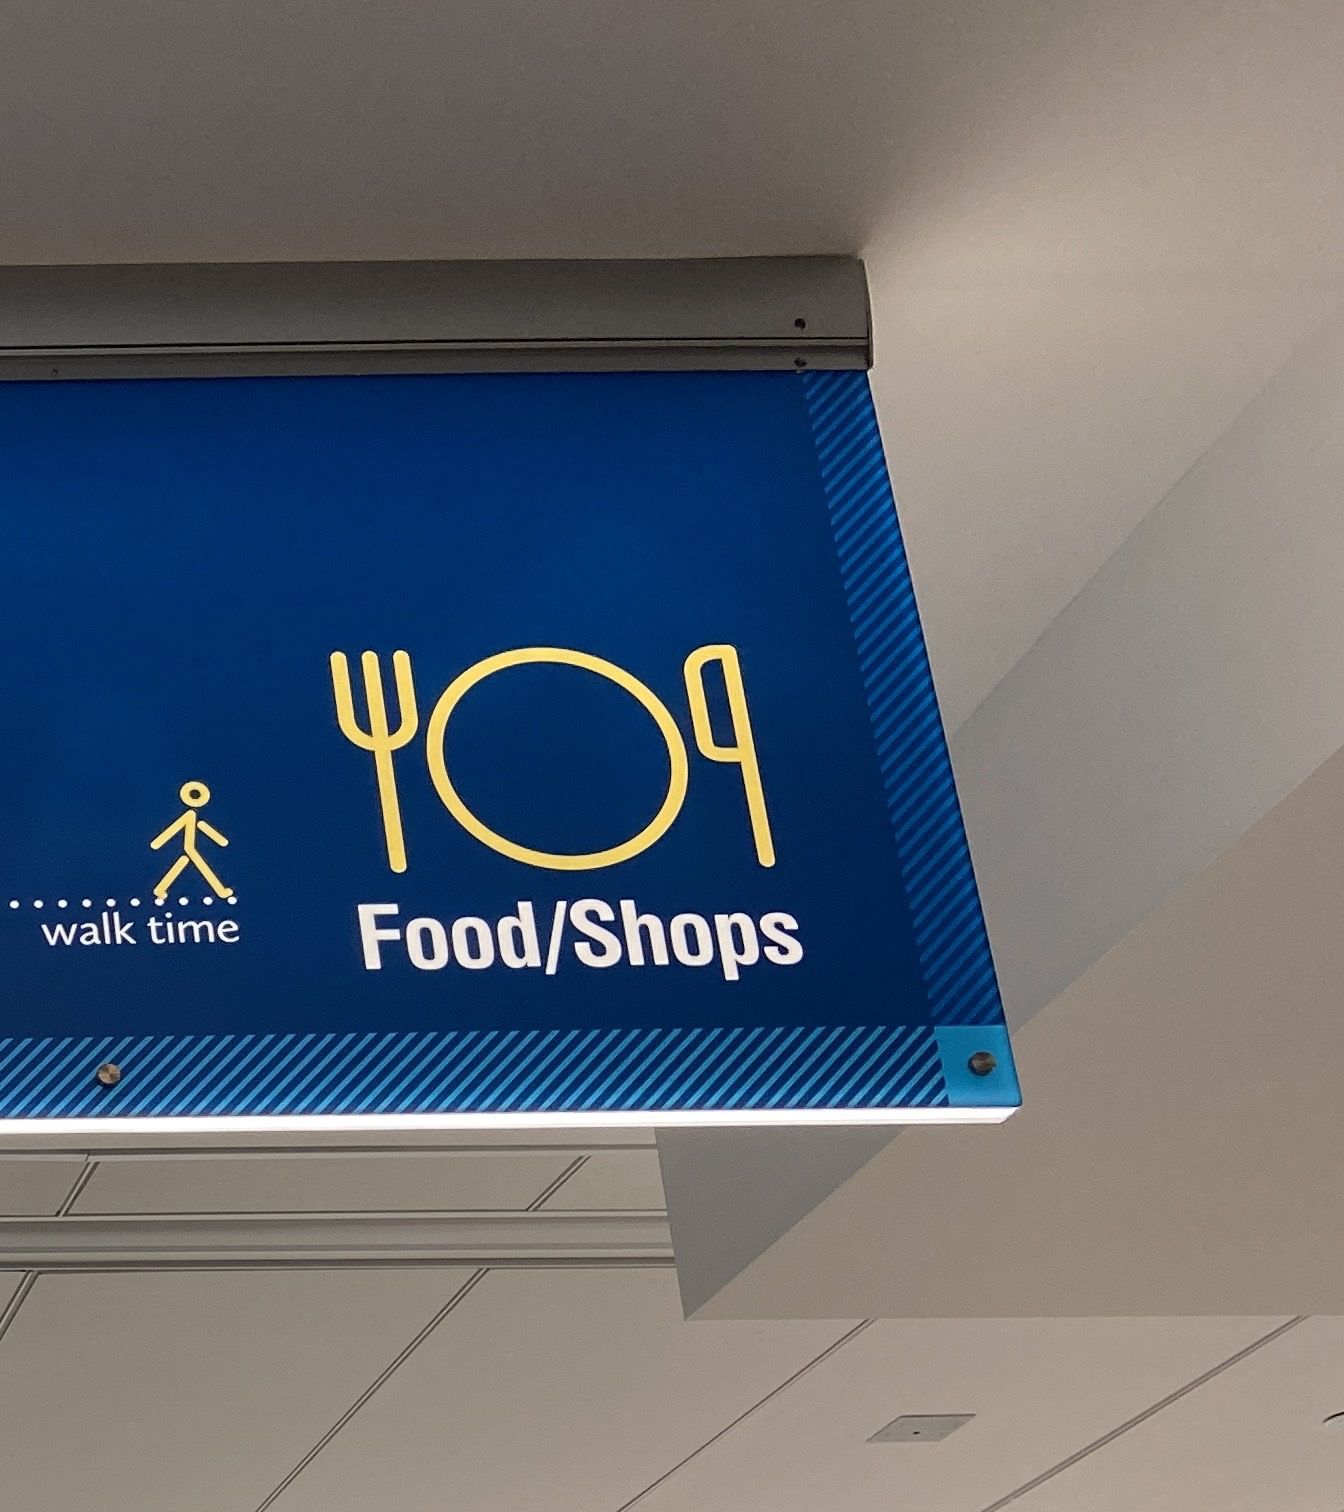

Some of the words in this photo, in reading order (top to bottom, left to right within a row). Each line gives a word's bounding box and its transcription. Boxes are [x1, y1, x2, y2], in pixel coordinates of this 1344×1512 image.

[41, 911, 136, 946] walk
[147, 912, 241, 944] time
[356, 897, 805, 982] Food/Shops
